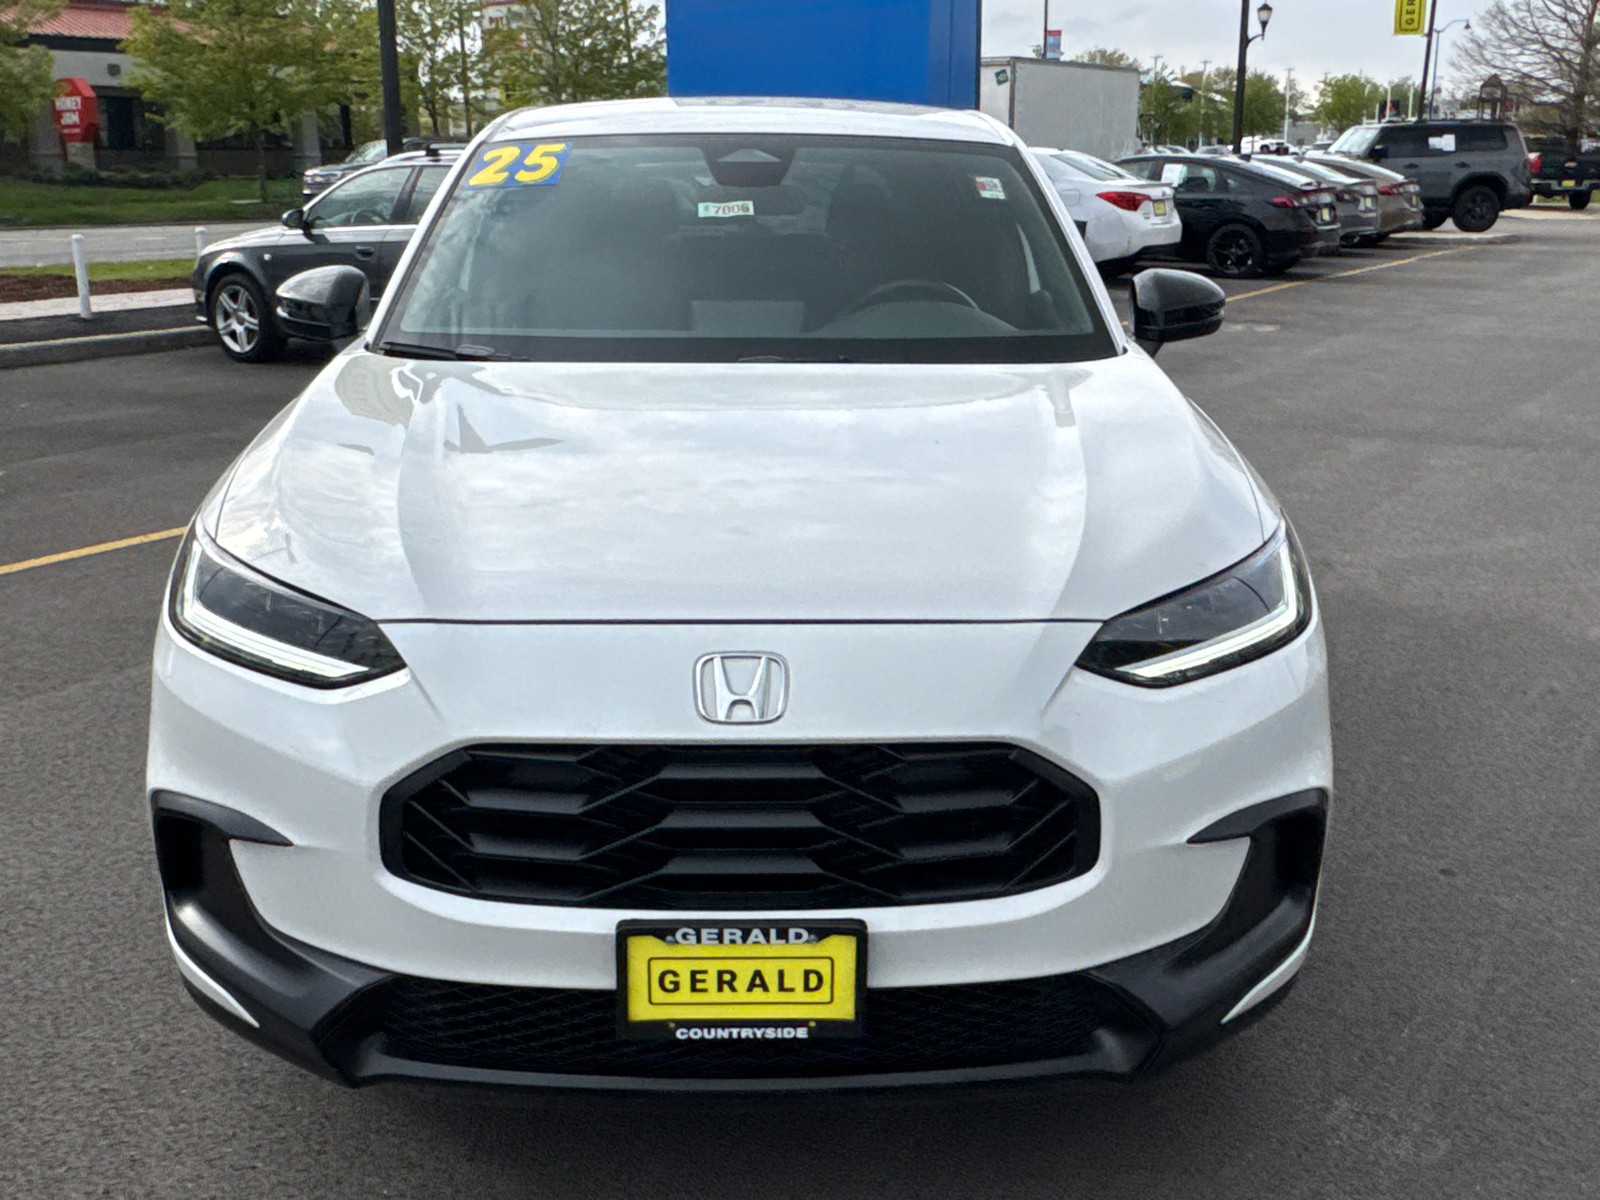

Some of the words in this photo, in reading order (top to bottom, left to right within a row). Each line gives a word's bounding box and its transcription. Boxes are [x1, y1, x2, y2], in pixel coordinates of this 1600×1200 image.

[468, 142, 566, 185] 25
[675, 927, 810, 945] GERALD
[657, 968, 825, 993] GERALD
[675, 1026, 809, 1040] COUNTRYSIDE
